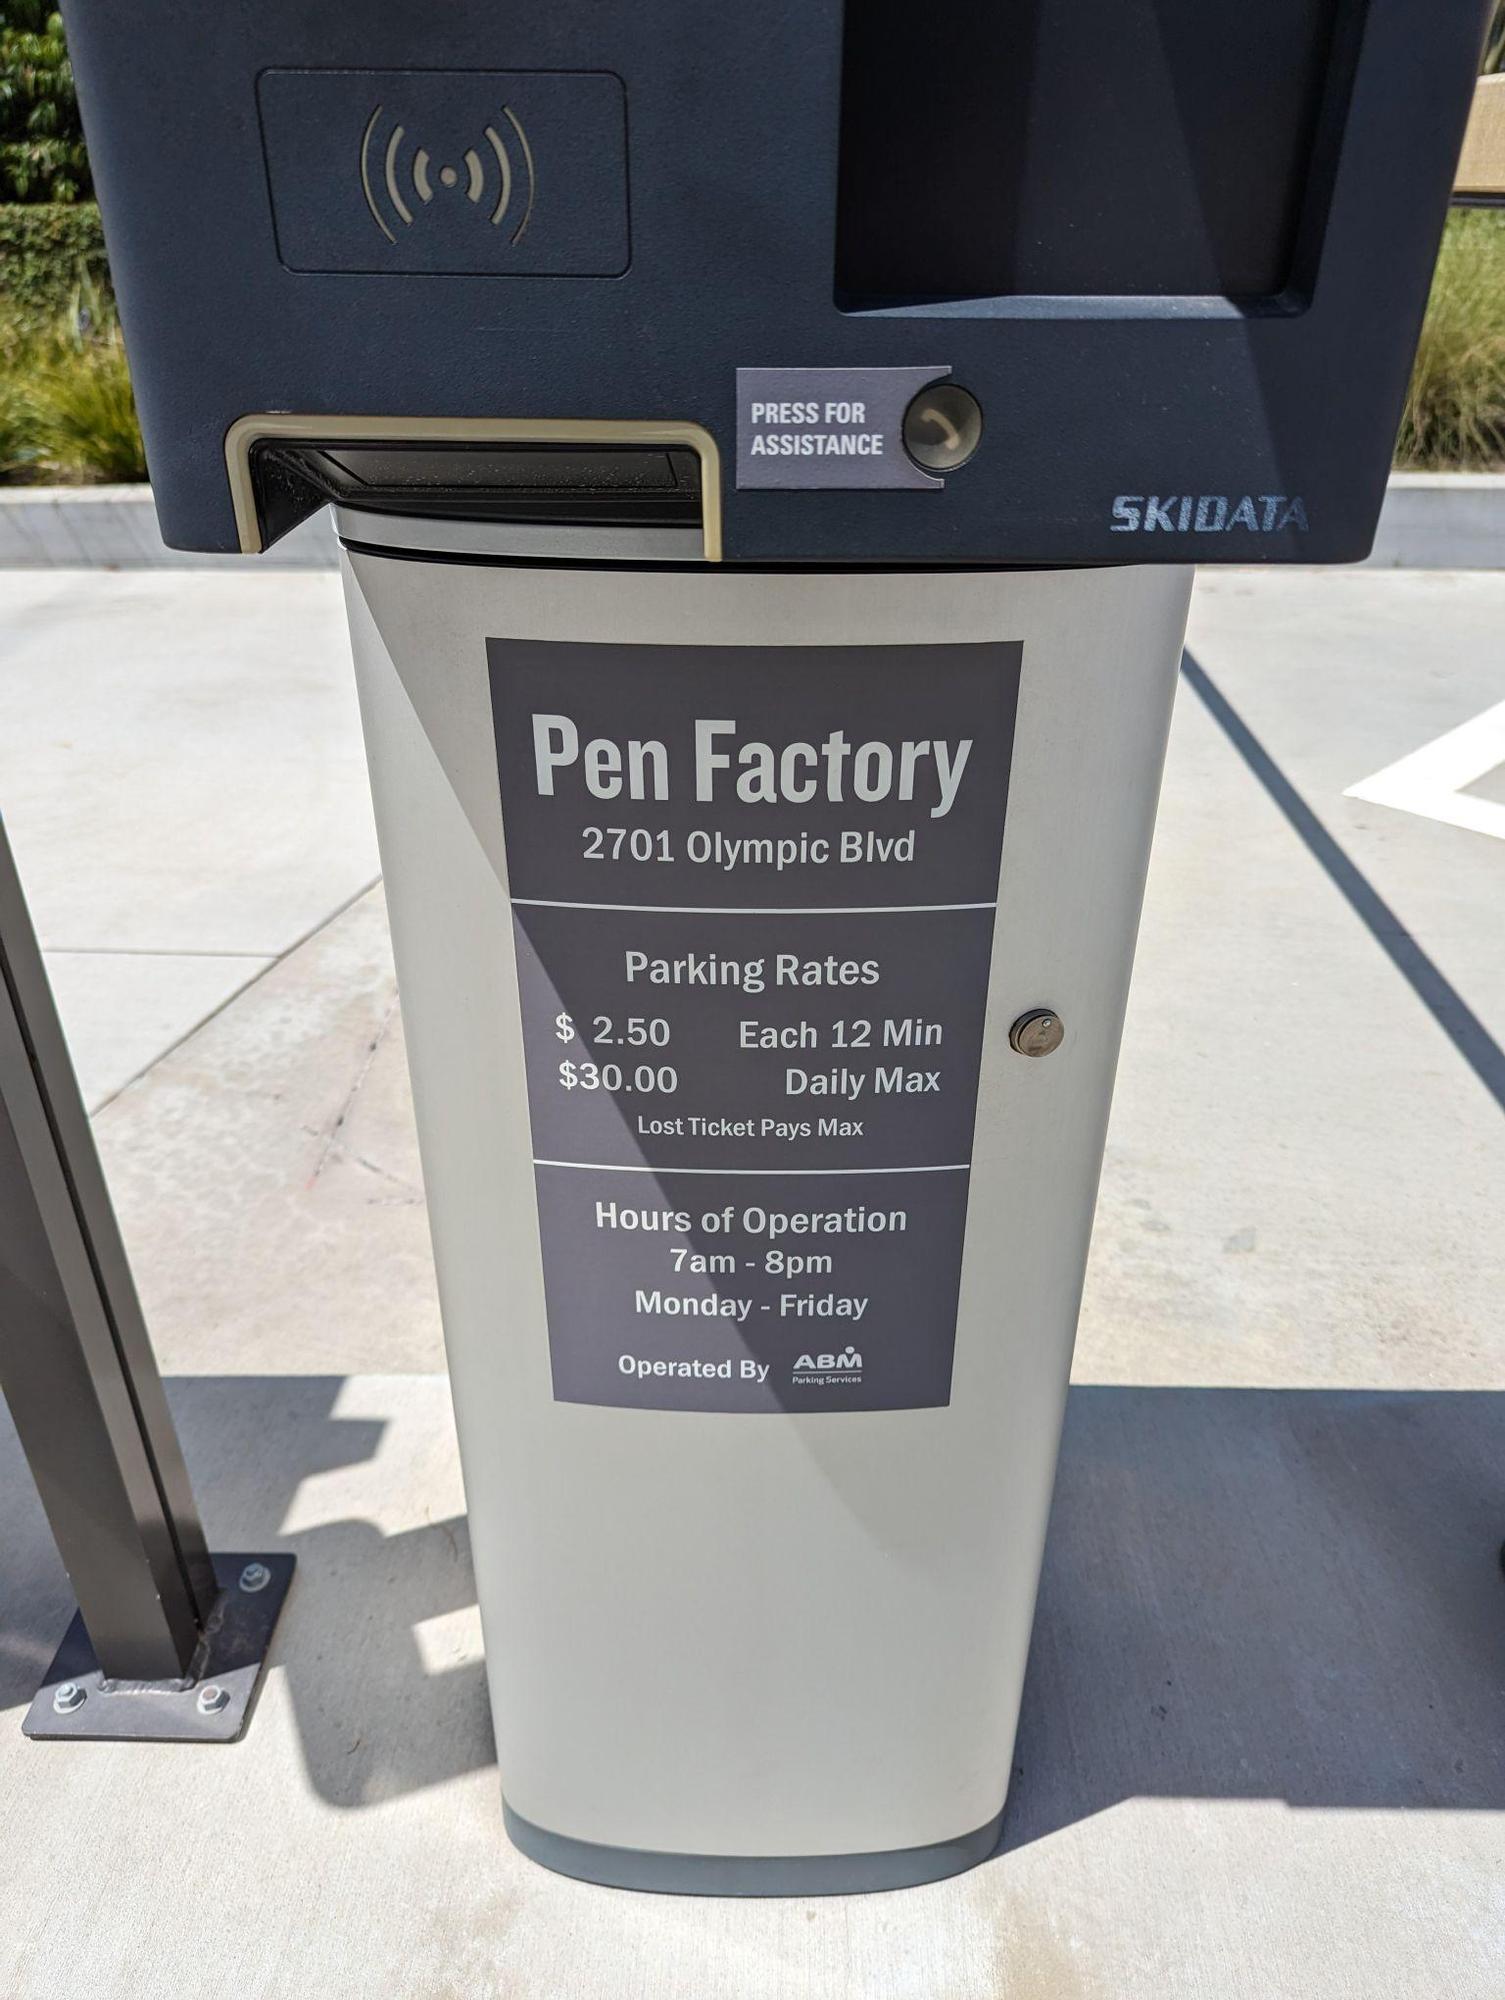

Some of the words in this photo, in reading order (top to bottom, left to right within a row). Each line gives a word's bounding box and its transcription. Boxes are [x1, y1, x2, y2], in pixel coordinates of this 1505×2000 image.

[752, 403, 819, 423] PRESS
[826, 403, 865, 423] FOR
[751, 434, 883, 455] ASSISTANCE
[1110, 495, 1309, 532] SKIDATA
[532, 714, 668, 800] Pen
[695, 720, 973, 818] Factory
[583, 827, 674, 861] 2701
[687, 831, 829, 870] Olympic
[841, 830, 915, 862] Blvd
[626, 951, 764, 993] Parking
[777, 955, 879, 985] Rates
[556, 1012, 574, 1043] $
[593, 1016, 669, 1046] 2.50
[741, 1021, 817, 1048] Each
[832, 1020, 871, 1047] 12
[884, 1019, 942, 1046] Min
[559, 1060, 677, 1093] $30.00
[787, 1069, 865, 1100] Daily
[875, 1067, 940, 1093] Max
[639, 1116, 684, 1135] Lost
[688, 1118, 755, 1136] Ticket
[762, 1119, 811, 1140] Pays
[819, 1119, 863, 1136] Max
[596, 1202, 691, 1231] Hours
[702, 1207, 734, 1232] of
[743, 1207, 906, 1239] Operation
[670, 1248, 734, 1273] 7am
[765, 1251, 831, 1278] 8pm
[636, 1290, 752, 1321] Monday
[781, 1294, 868, 1320] Friday
[619, 1355, 731, 1378] Operated
[741, 1360, 769, 1382] By
[793, 1347, 862, 1369] ABM
[792, 1375, 824, 1386] Parking
[825, 1375, 862, 1385] Services
